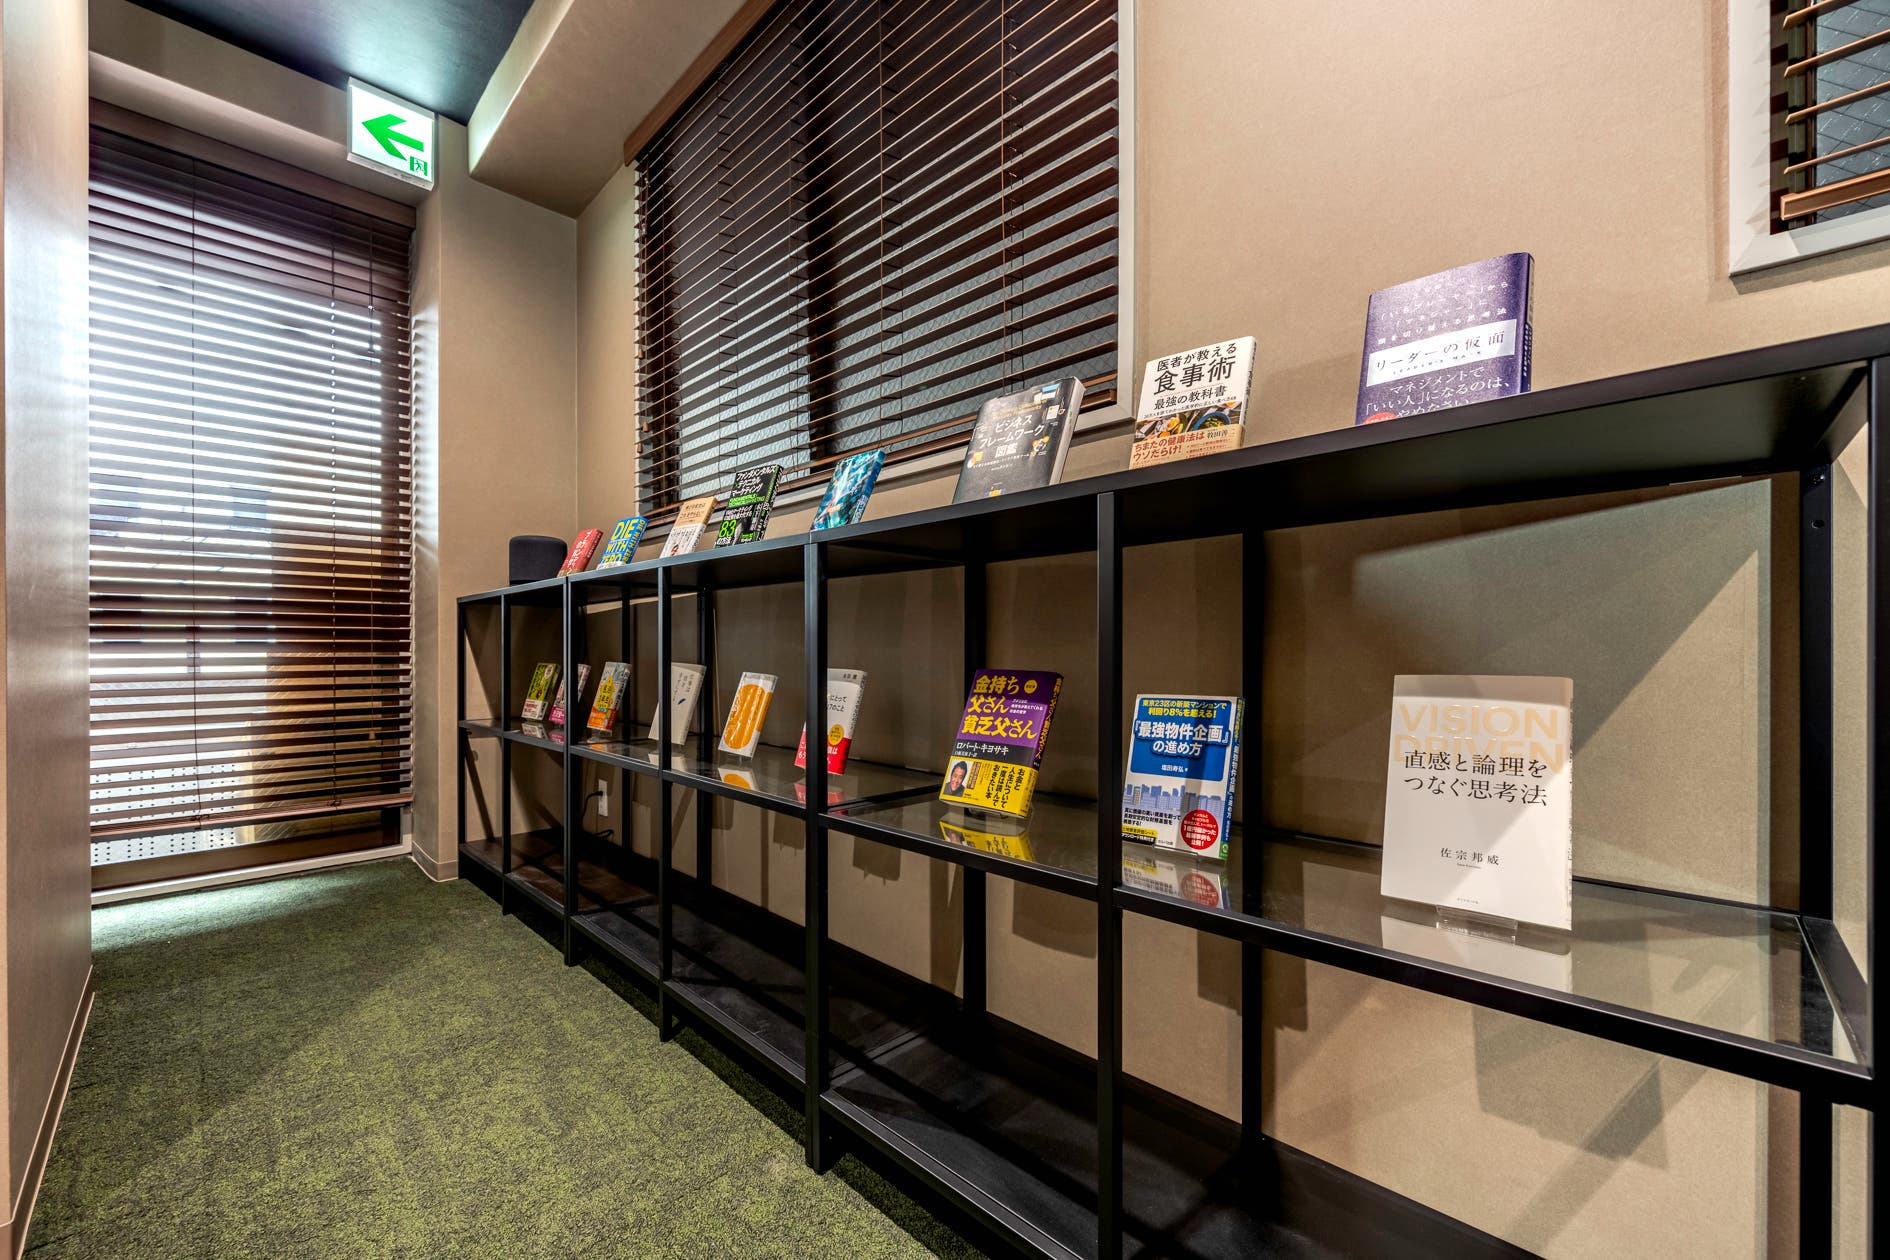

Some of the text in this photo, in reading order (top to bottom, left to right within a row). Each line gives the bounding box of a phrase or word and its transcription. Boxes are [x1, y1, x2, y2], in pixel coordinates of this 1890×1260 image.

[1157, 343, 1237, 371] 医者が教える
[1377, 331, 1504, 371] リーダーの仮面
[1154, 355, 1236, 395] 食事術
[1390, 366, 1485, 394] マネジメントで
[1154, 385, 1228, 410] 最強の教科書
[995, 414, 1033, 433] ビジネス
[980, 424, 1045, 449] フレームワーク
[1135, 431, 1205, 451] ちまたの健康法は
[611, 519, 639, 540] DIE
[719, 519, 737, 537] 83
[606, 540, 628, 554] WITH
[973, 675, 1020, 695] 金持ち
[967, 694, 1010, 714] 父さん
[1142, 700, 1227, 710] 東京23区の新築マンションで
[961, 715, 1038, 739] 貧乏父さん
[1135, 720, 1229, 744] 『最強物件企画』
[1400, 703, 1558, 740] VISION
[956, 741, 1009, 756] ロバート・キヨサキ
[1153, 741, 1203, 756] の進め方
[1404, 749, 1547, 778] 直感と論理を
[1001, 767, 1016, 808] 人生について
[1014, 768, 1025, 791] お金と
[1404, 775, 1547, 806] つなぐ思考法
[1440, 847, 1500, 866] 佐宗邦威
